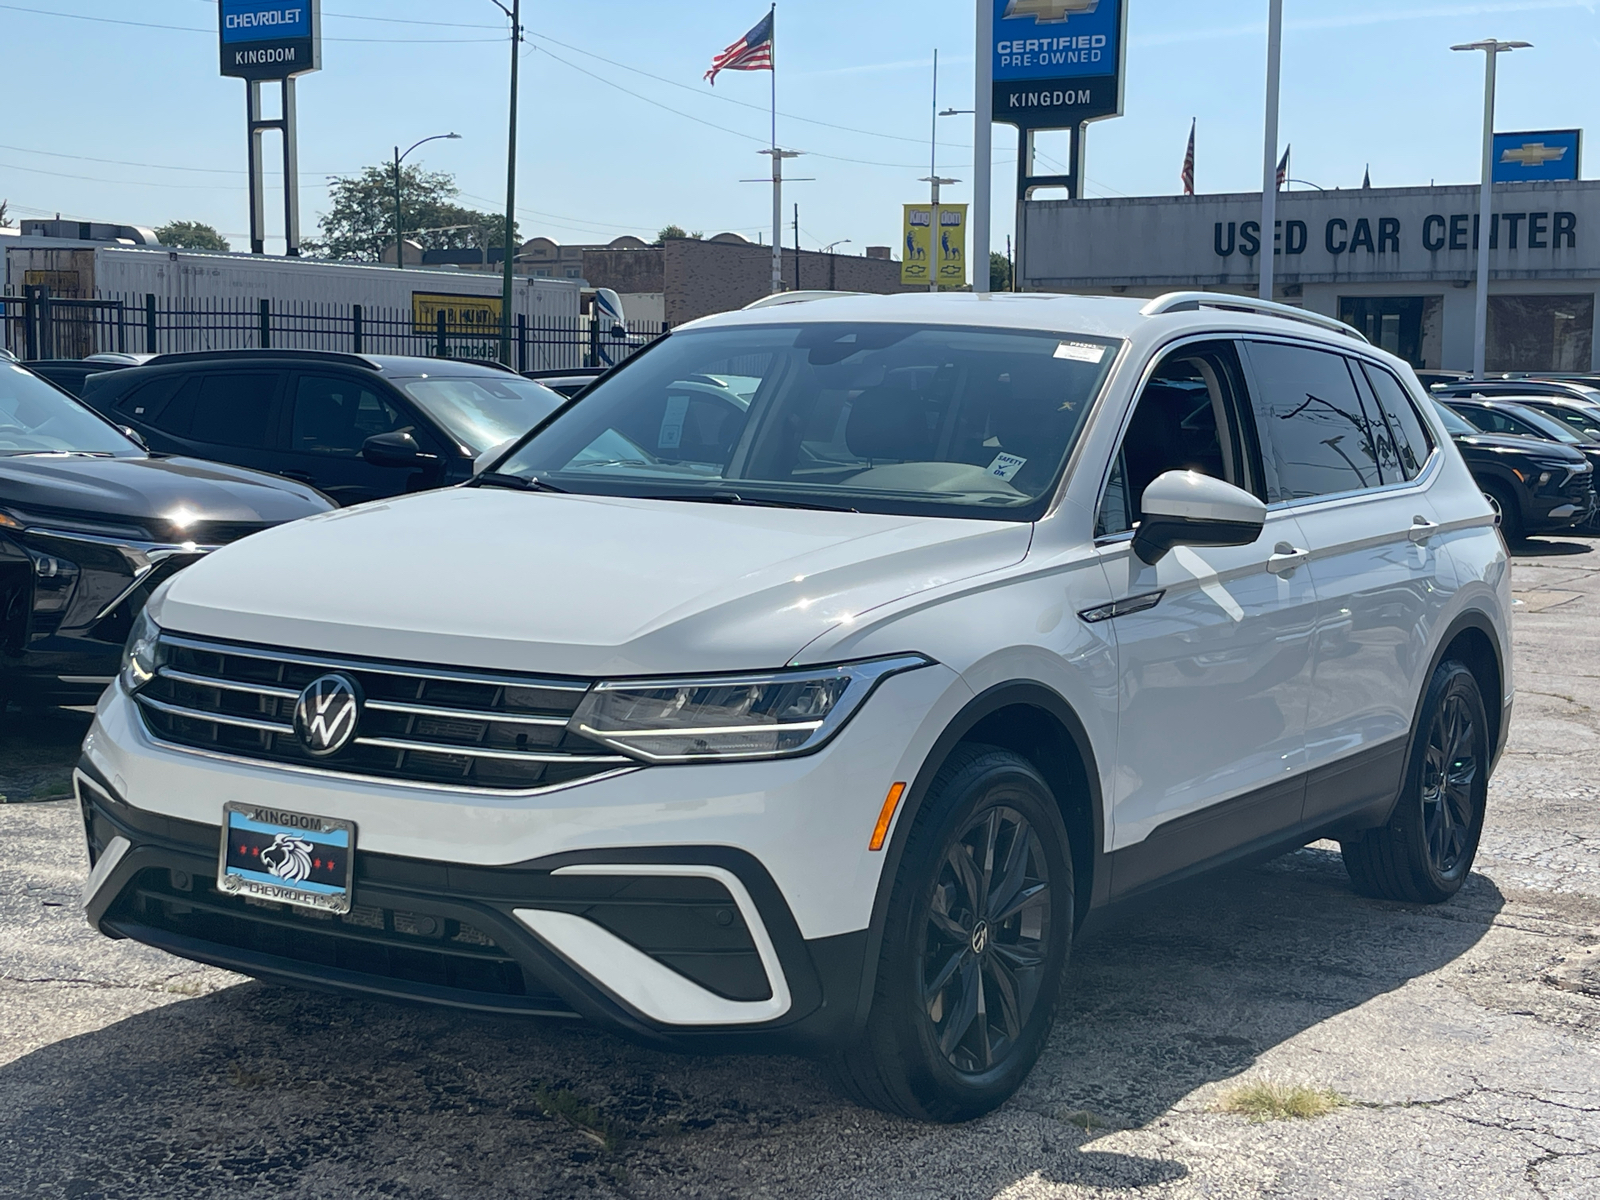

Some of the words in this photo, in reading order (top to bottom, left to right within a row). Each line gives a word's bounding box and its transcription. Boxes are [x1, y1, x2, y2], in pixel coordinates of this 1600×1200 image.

[226, 9, 301, 28] CHEVROLET
[997, 34, 1106, 54] CERTIFIED
[235, 47, 295, 65] KINGDOM
[1001, 50, 1101, 67] PRE-OWNED
[1009, 89, 1091, 107] KINGDOM
[909, 209, 930, 226] King
[1324, 217, 1401, 254] CAR
[1422, 211, 1576, 251] CENTER
[426, 340, 499, 358] Inermodal
[997, 455, 1023, 466] SAFETY
[993, 469, 1006, 477] OK
[254, 808, 322, 831] KINGDOM
[249, 883, 319, 905] CHEVROLET
